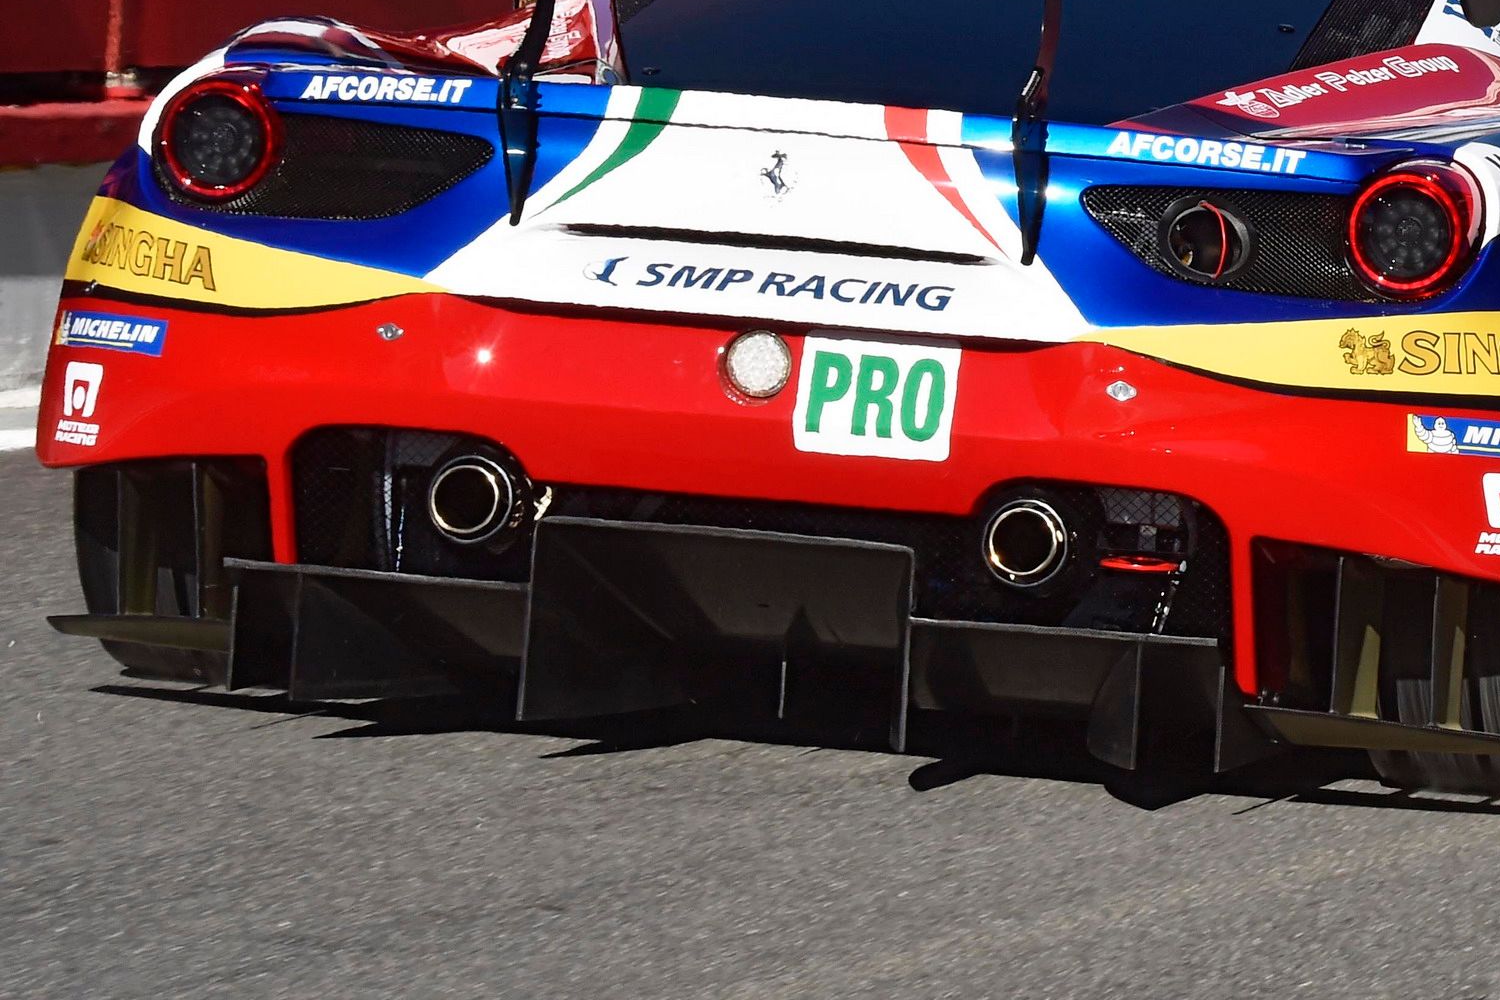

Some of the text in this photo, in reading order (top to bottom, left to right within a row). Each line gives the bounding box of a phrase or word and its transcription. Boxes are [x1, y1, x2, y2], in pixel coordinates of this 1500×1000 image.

[299, 75, 473, 104] AFCORSE.IT
[1256, 55, 1461, 109] Adler Pelzer Group
[1105, 131, 1307, 175] AFCORSE.IT
[90, 222, 217, 292] SINGHA
[636, 262, 956, 312] SMP RACING
[70, 317, 160, 344] MICHELIN
[805, 350, 945, 442] PRO
